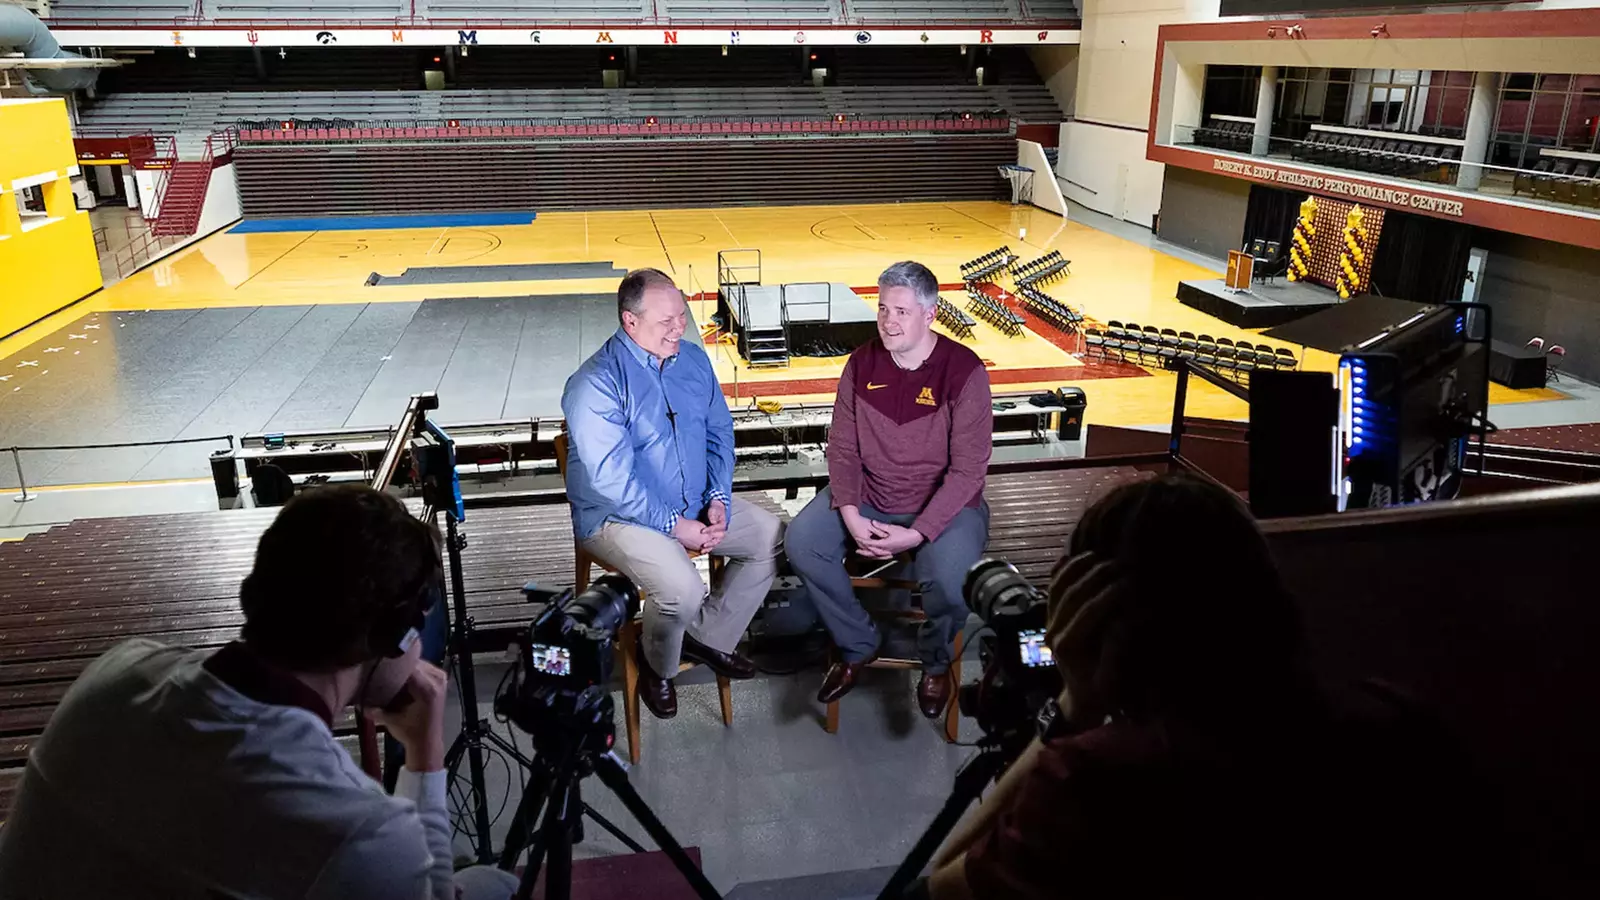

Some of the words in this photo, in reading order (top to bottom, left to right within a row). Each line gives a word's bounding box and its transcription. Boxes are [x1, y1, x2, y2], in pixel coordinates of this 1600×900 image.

[392, 30, 403, 42] M
[458, 30, 477, 44] M
[596, 31, 613, 43] M
[664, 31, 677, 44] N
[980, 29, 993, 43] R
[1213, 159, 1244, 175] ROBERT
[1243, 164, 1252, 176] K.
[1253, 166, 1277, 180] EDDY
[1276, 170, 1324, 189] ATHLETIC
[1324, 178, 1410, 205] PERFORMANCE
[1410, 194, 1463, 216] CENTER
[919, 387, 935, 400] M
